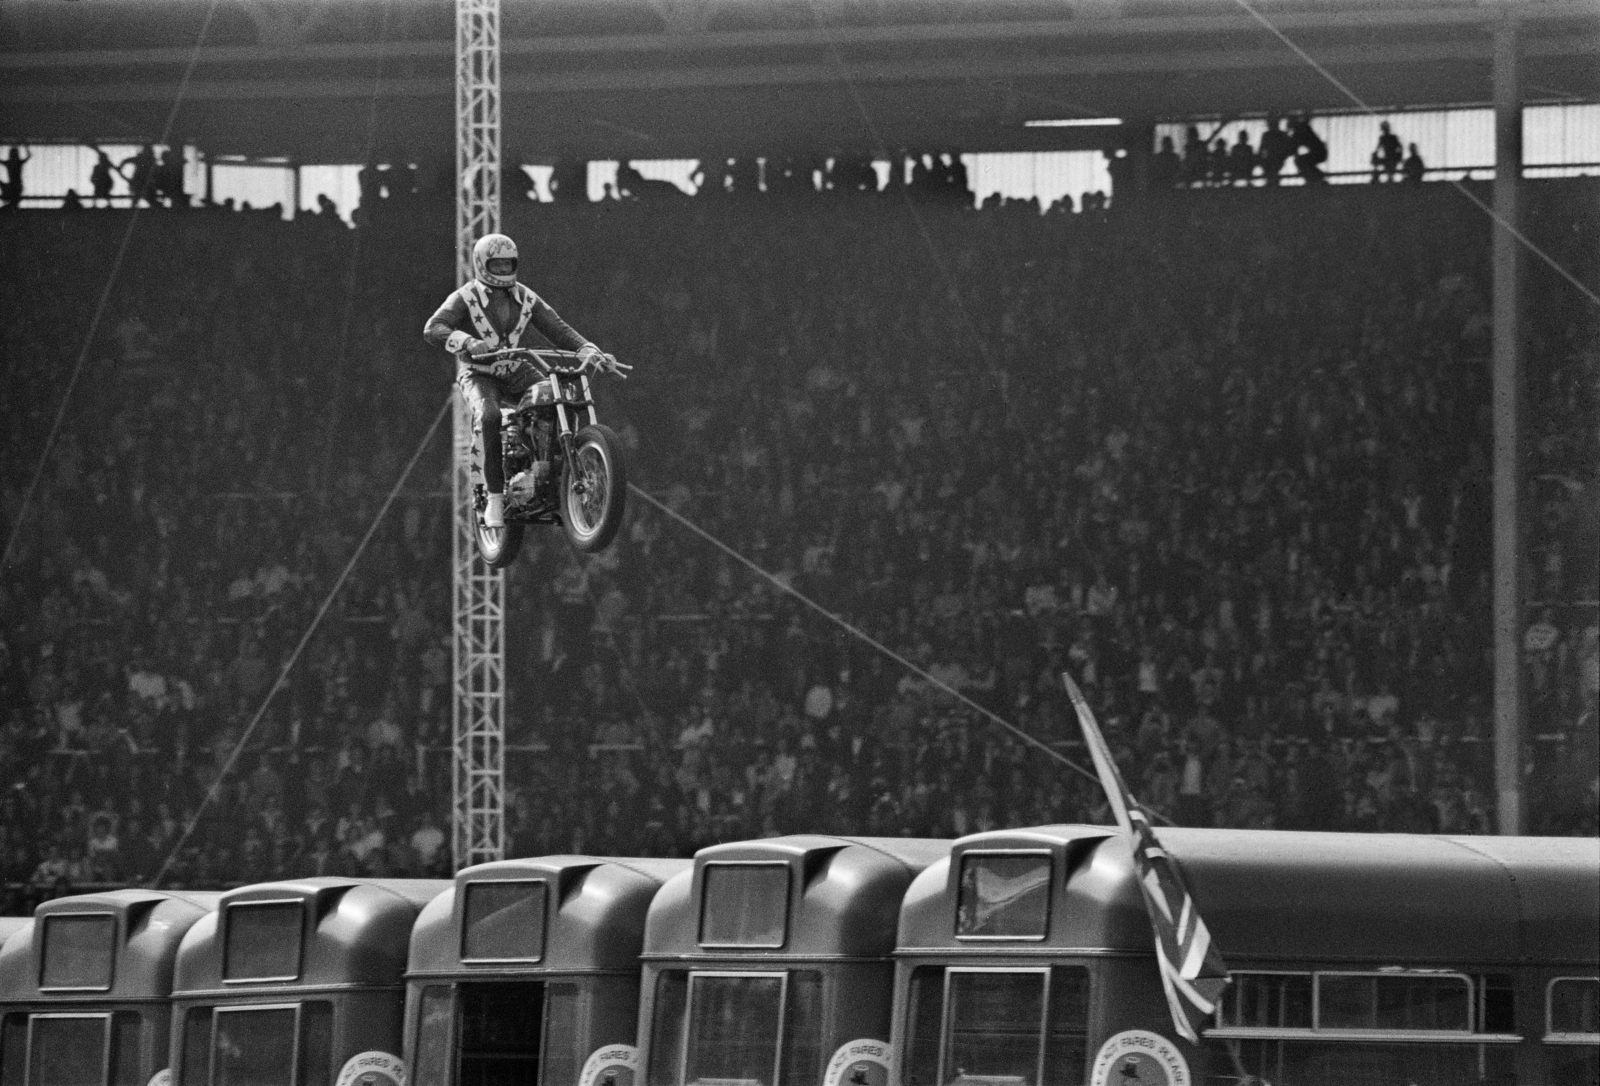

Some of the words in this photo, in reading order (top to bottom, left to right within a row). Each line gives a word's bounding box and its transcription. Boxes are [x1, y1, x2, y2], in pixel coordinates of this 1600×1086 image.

[1120, 1036, 1156, 1050] FARES
[600, 1050, 631, 1061] FARES
[850, 1045, 882, 1057] FARES
[359, 1057, 390, 1069] FARES
